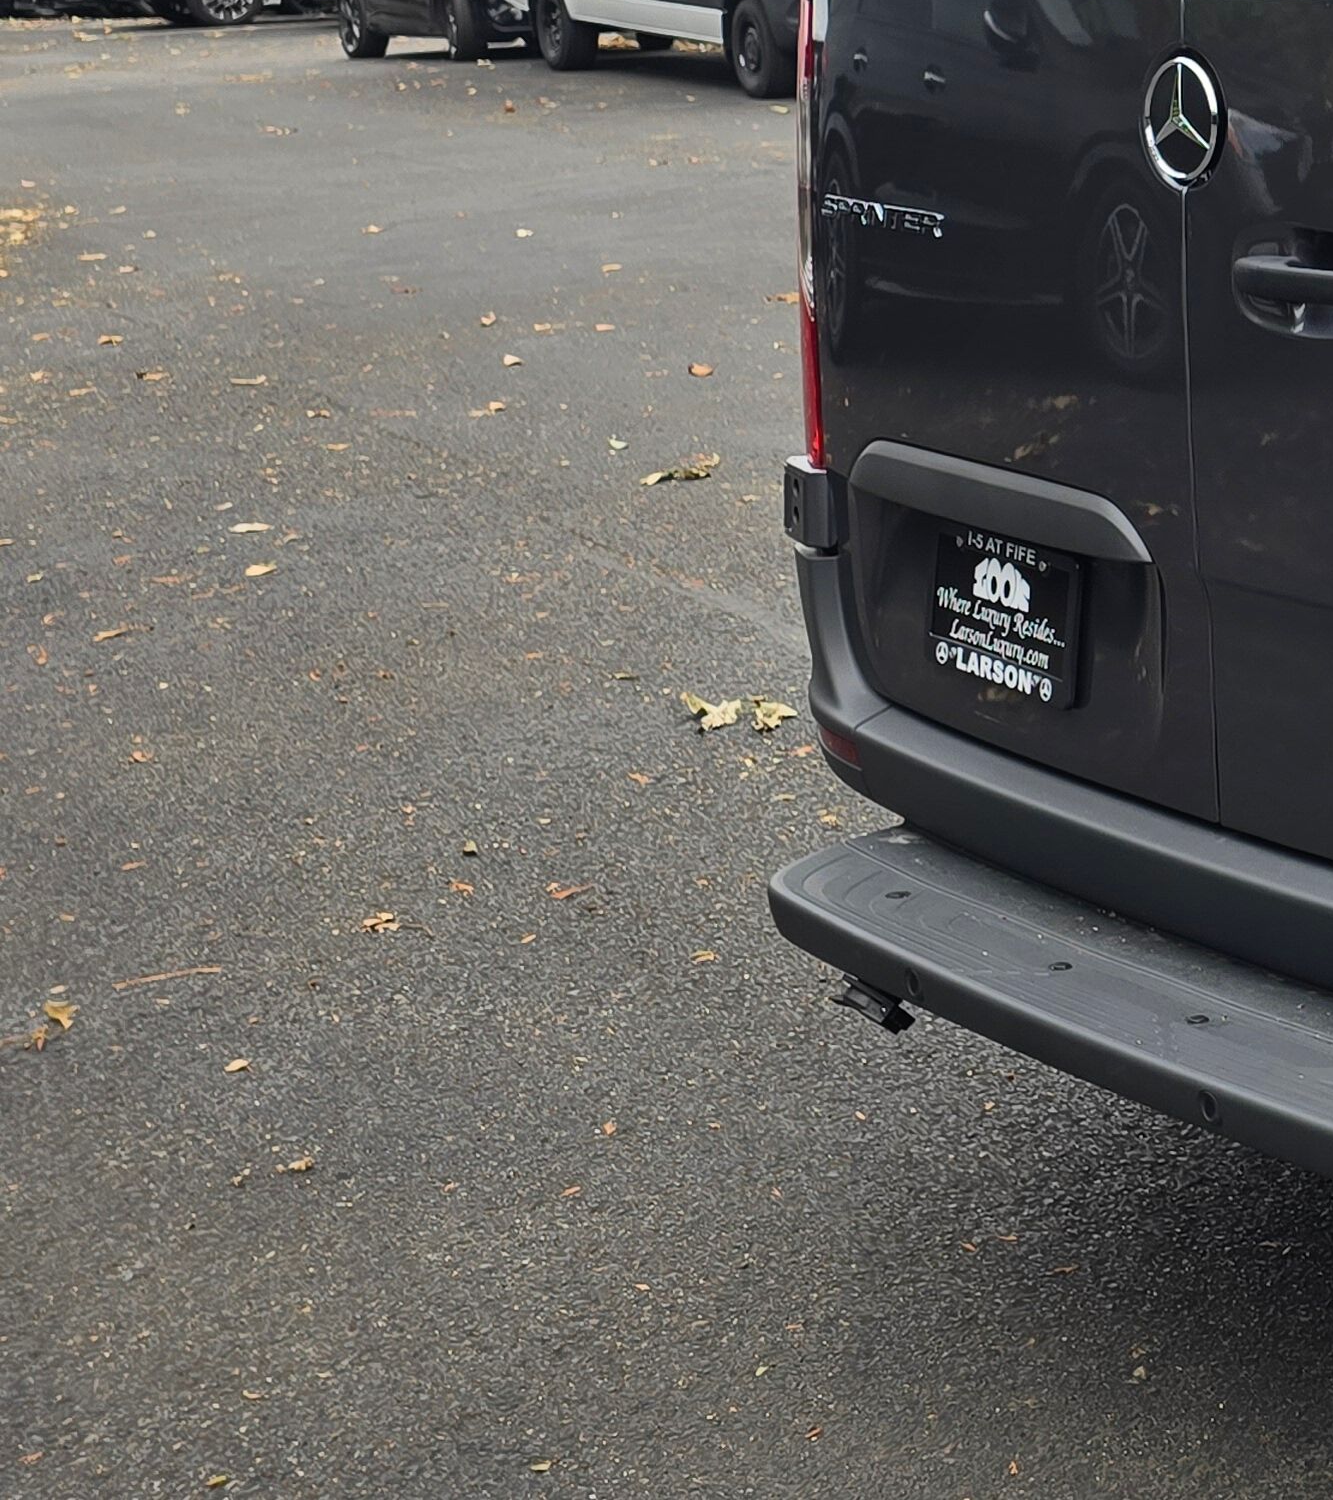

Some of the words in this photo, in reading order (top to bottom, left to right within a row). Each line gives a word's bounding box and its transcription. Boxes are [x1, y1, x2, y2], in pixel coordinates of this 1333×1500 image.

[821, 193, 945, 238] SPRINTER
[967, 530, 984, 549] I-5
[985, 538, 1003, 555] AT
[1006, 543, 1036, 566] FIFE
[936, 586, 971, 616] Where
[972, 599, 1012, 637] Luxury
[949, 618, 1050, 670] LarsonLuxury.com
[955, 647, 1032, 695] LARSON
